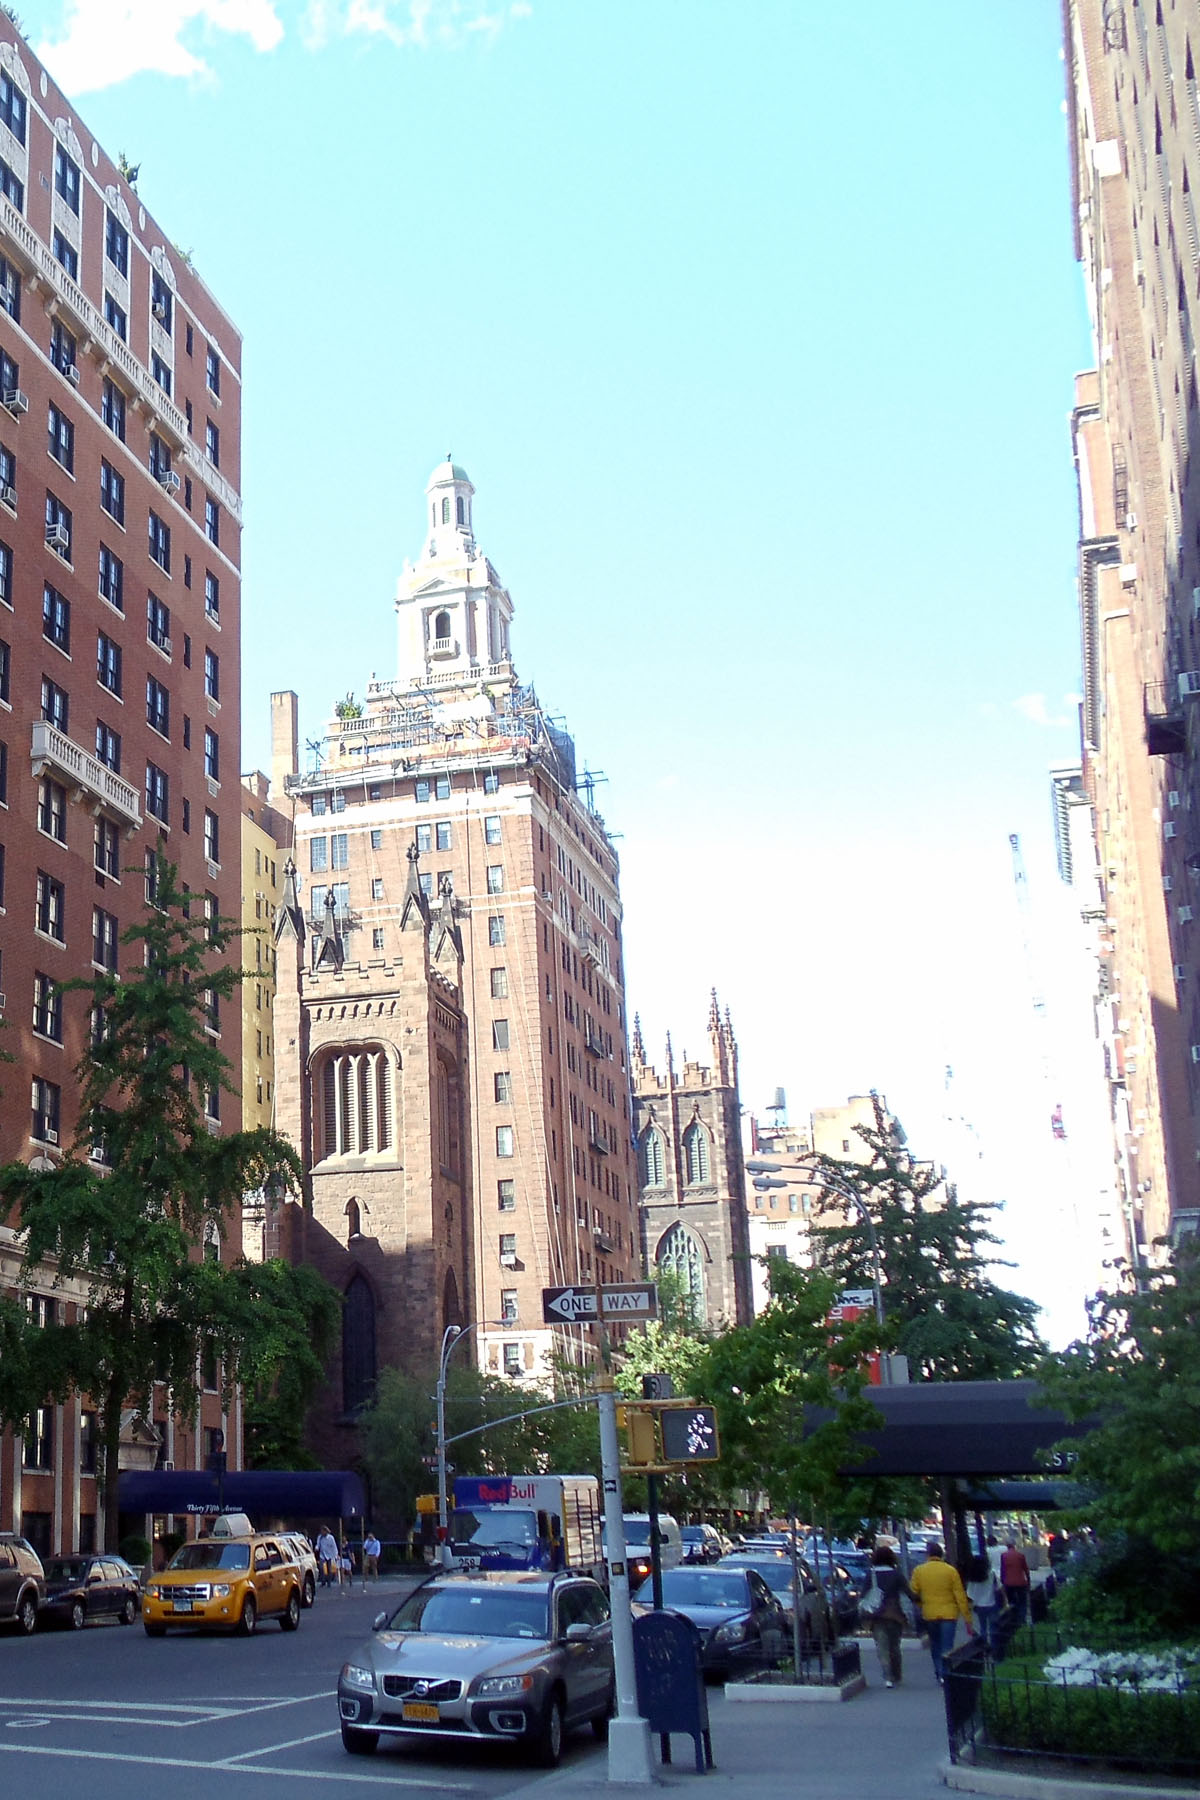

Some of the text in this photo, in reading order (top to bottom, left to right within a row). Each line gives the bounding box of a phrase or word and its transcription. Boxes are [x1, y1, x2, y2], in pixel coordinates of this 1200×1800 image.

[560, 1295, 641, 1312] ONE WAY
[478, 1483, 536, 1500] Red Bull
[186, 1503, 243, 1514] Thirty Fifth Avenue
[458, 1557, 475, 1568] 258
